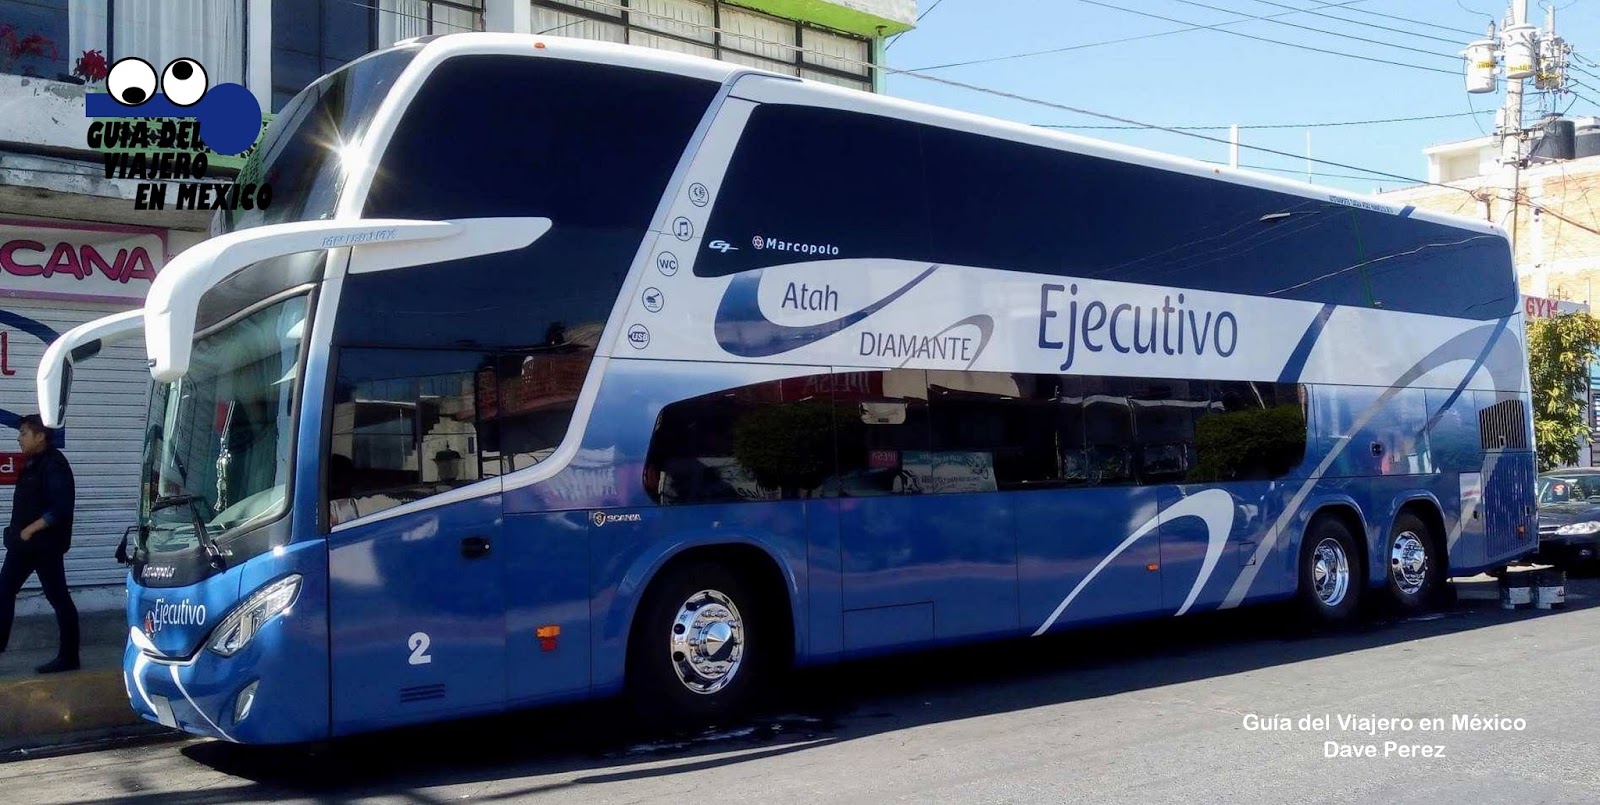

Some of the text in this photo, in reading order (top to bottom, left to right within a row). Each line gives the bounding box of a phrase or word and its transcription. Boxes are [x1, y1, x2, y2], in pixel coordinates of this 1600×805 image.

[765, 237, 839, 255] Marcopolo
[0, 239, 157, 284] CANA
[659, 259, 676, 270] WC
[781, 281, 838, 312] Atah
[1525, 296, 1559, 319] GYM
[631, 332, 649, 342] USB
[1038, 283, 1239, 371] Ejecutivo
[859, 331, 972, 361] DIAMANTE
[606, 513, 642, 523] SCANIA
[153, 598, 206, 631] Ejecutivo
[408, 631, 431, 666] 2
